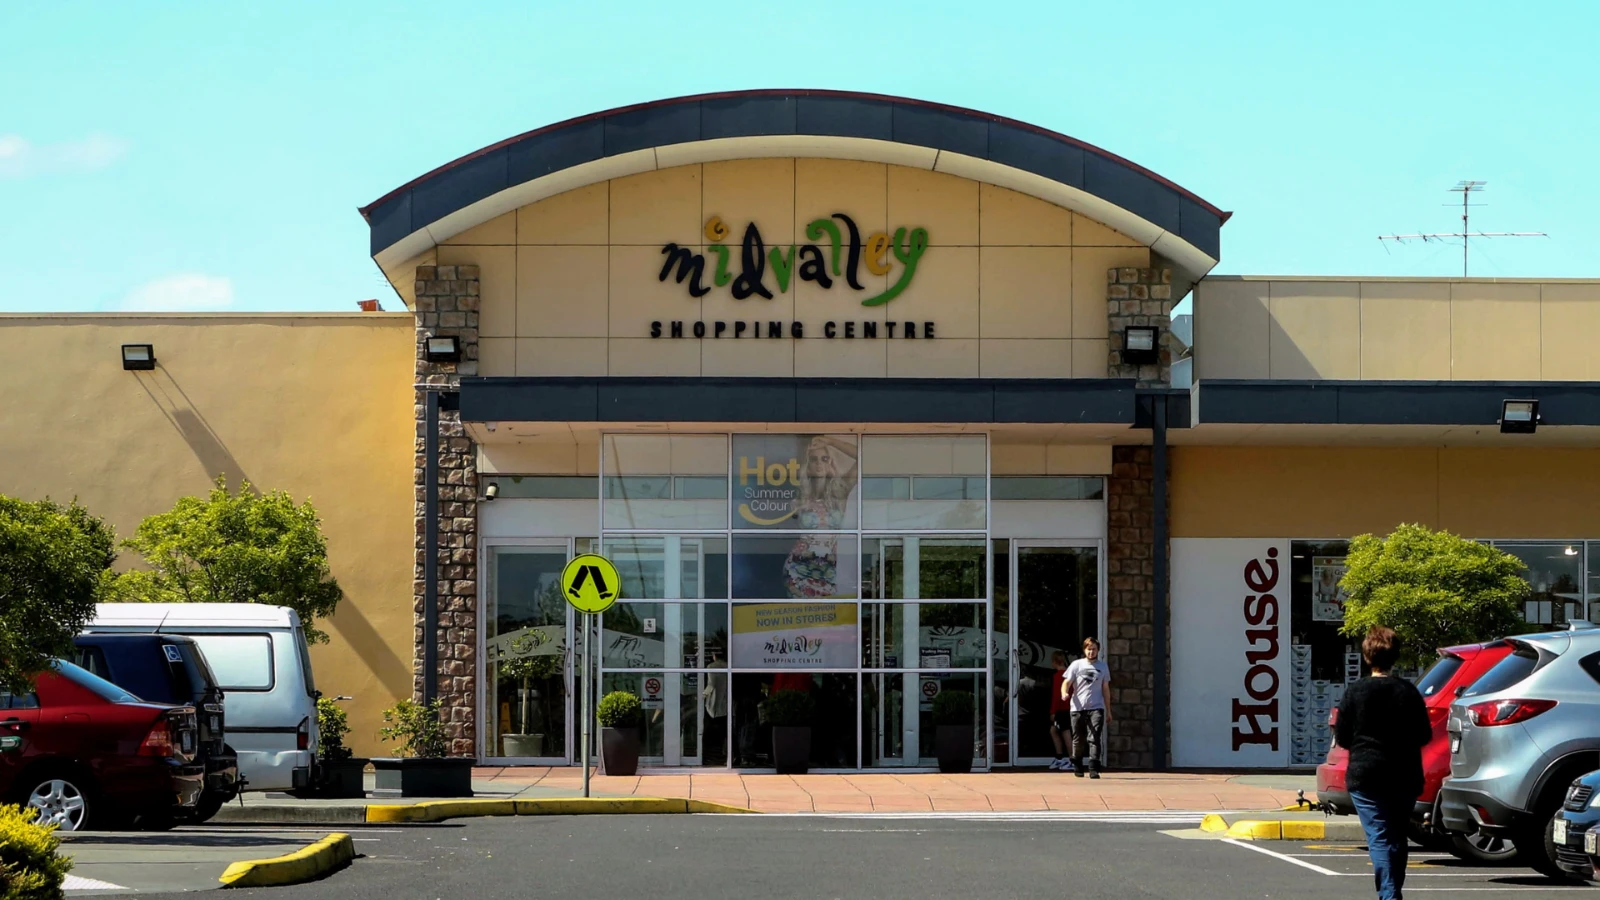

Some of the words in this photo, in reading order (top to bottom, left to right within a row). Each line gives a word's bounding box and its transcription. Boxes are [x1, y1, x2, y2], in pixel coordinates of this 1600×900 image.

[658, 212, 929, 307] midvalley
[650, 320, 804, 340] SHOPPING
[823, 320, 936, 340] CENTRE
[739, 455, 801, 487] Hot
[744, 487, 796, 499] Summer
[750, 499, 789, 512] Colour
[755, 609, 773, 617] NEW
[773, 606, 803, 615] SEASON
[804, 604, 836, 612] FASHION
[756, 618, 780, 627] NOW
[782, 616, 793, 625] IN
[796, 612, 837, 624] STORES!
[764, 634, 823, 656] midvalley
